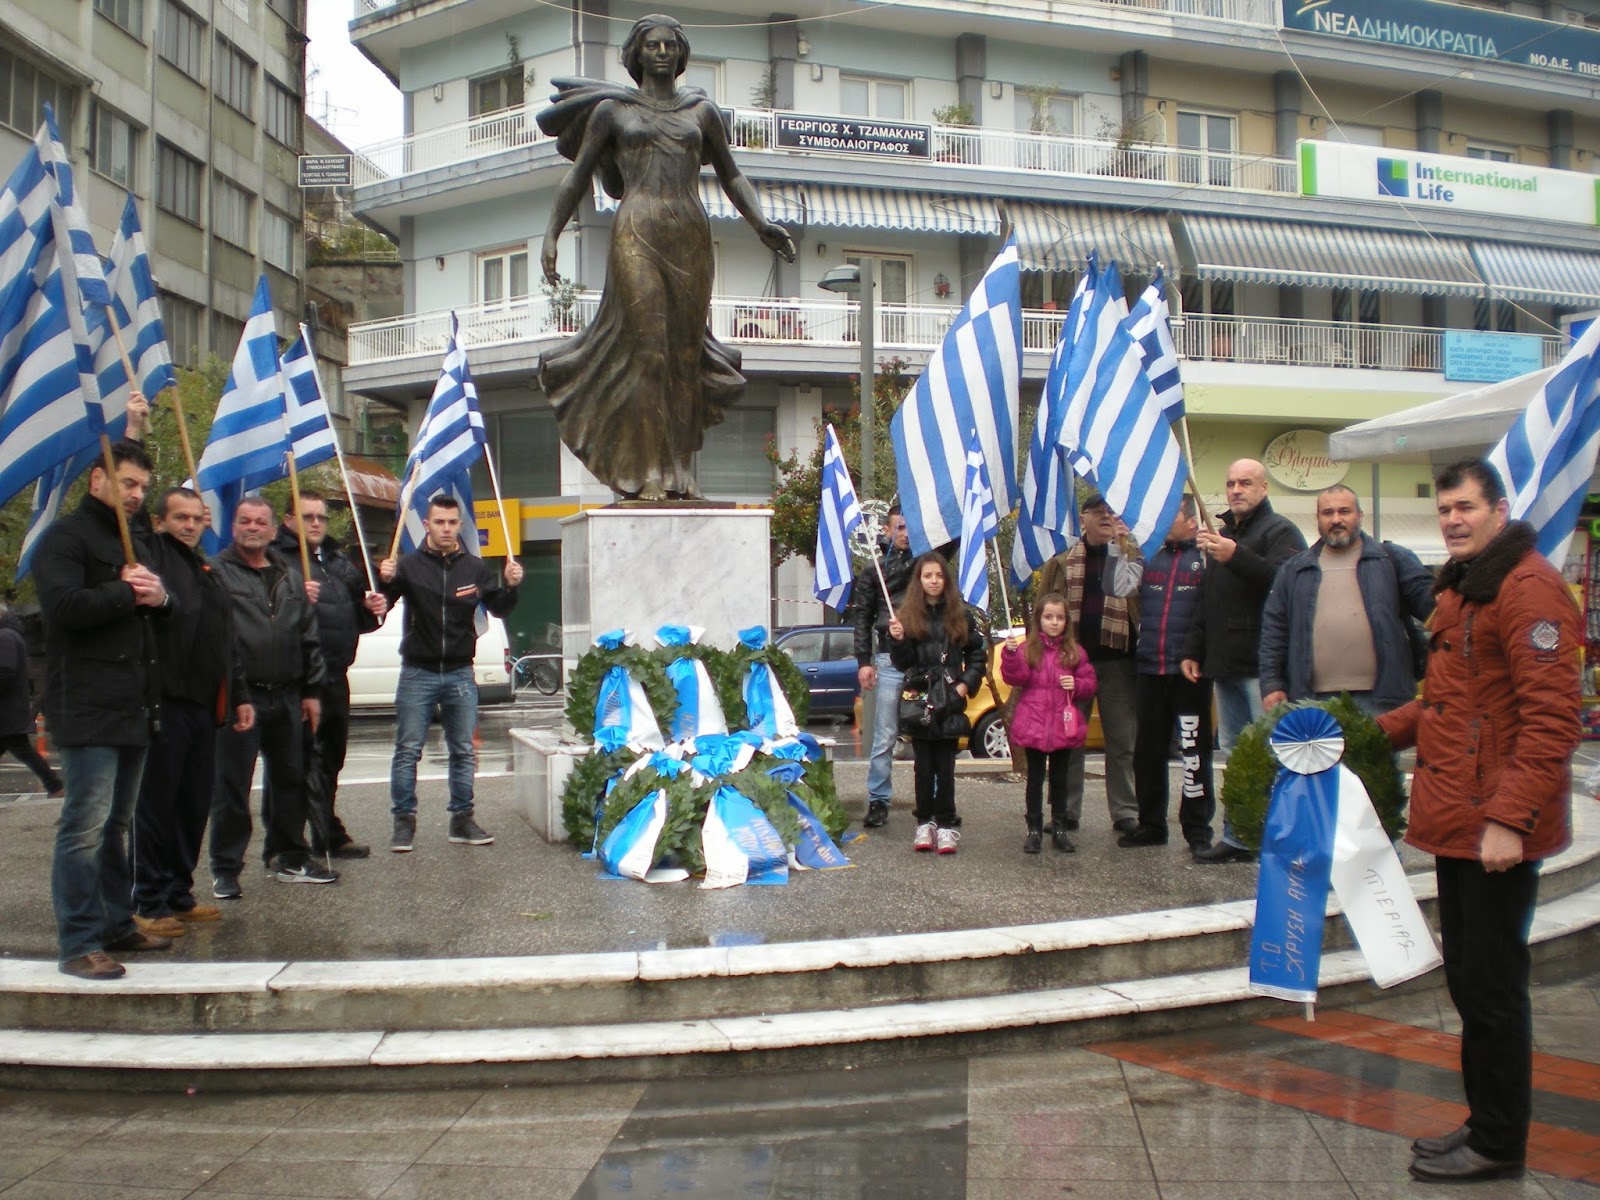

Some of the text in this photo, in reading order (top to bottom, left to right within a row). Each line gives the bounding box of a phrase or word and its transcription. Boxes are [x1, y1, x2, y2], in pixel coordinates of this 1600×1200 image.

[781, 119, 926, 141] ΓΕΩΡΓΙΟΣ Χ. ΤΖΑΜΑΚΛΗΣ
[799, 135, 909, 153] ΣΥΜΒΟΛΑΙΟΓΡΑΦΟΣ
[1416, 162, 1538, 192] International
[1417, 183, 1454, 202] Life
